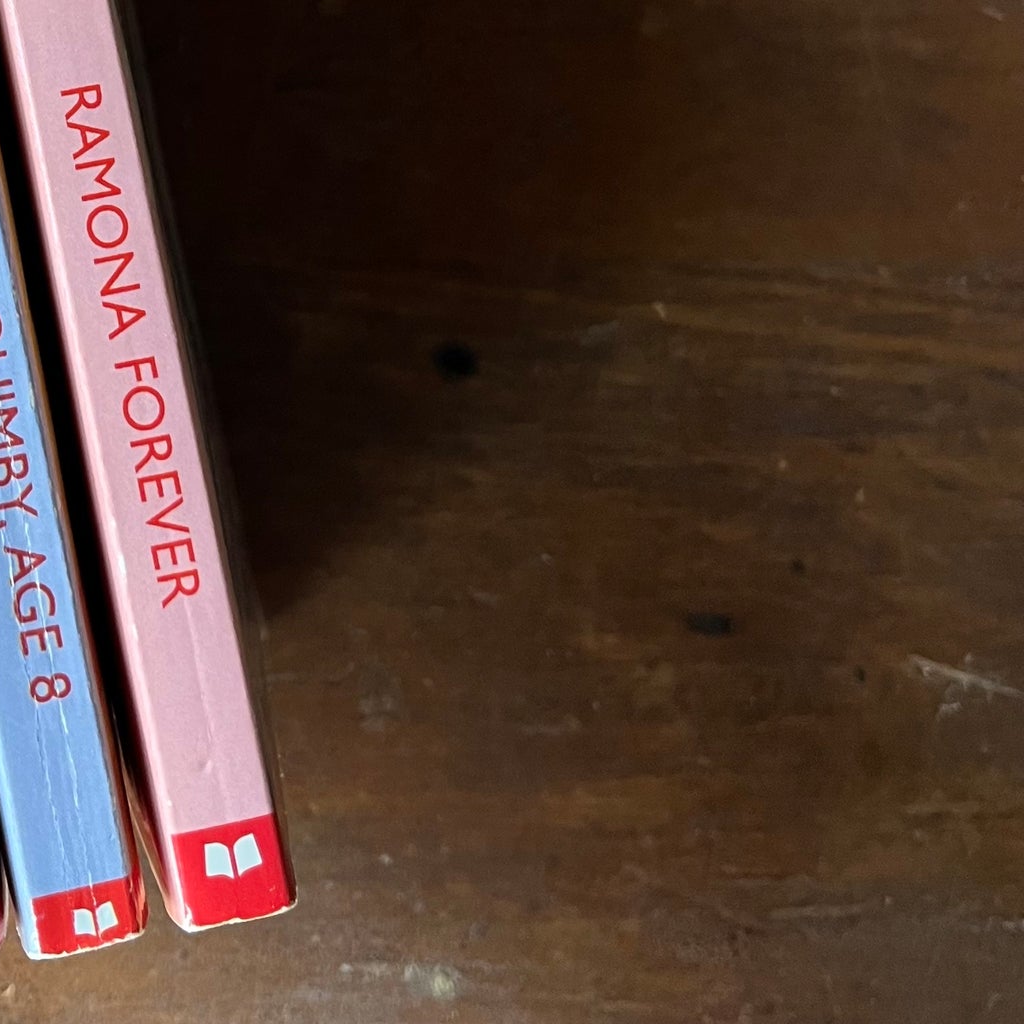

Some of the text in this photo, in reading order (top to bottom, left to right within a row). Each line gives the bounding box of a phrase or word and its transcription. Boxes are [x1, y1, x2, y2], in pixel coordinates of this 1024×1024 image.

[60, 83, 201, 609] RAMONA FOREVER
[3, 544, 64, 657] AGE
[29, 672, 72, 705] 8
